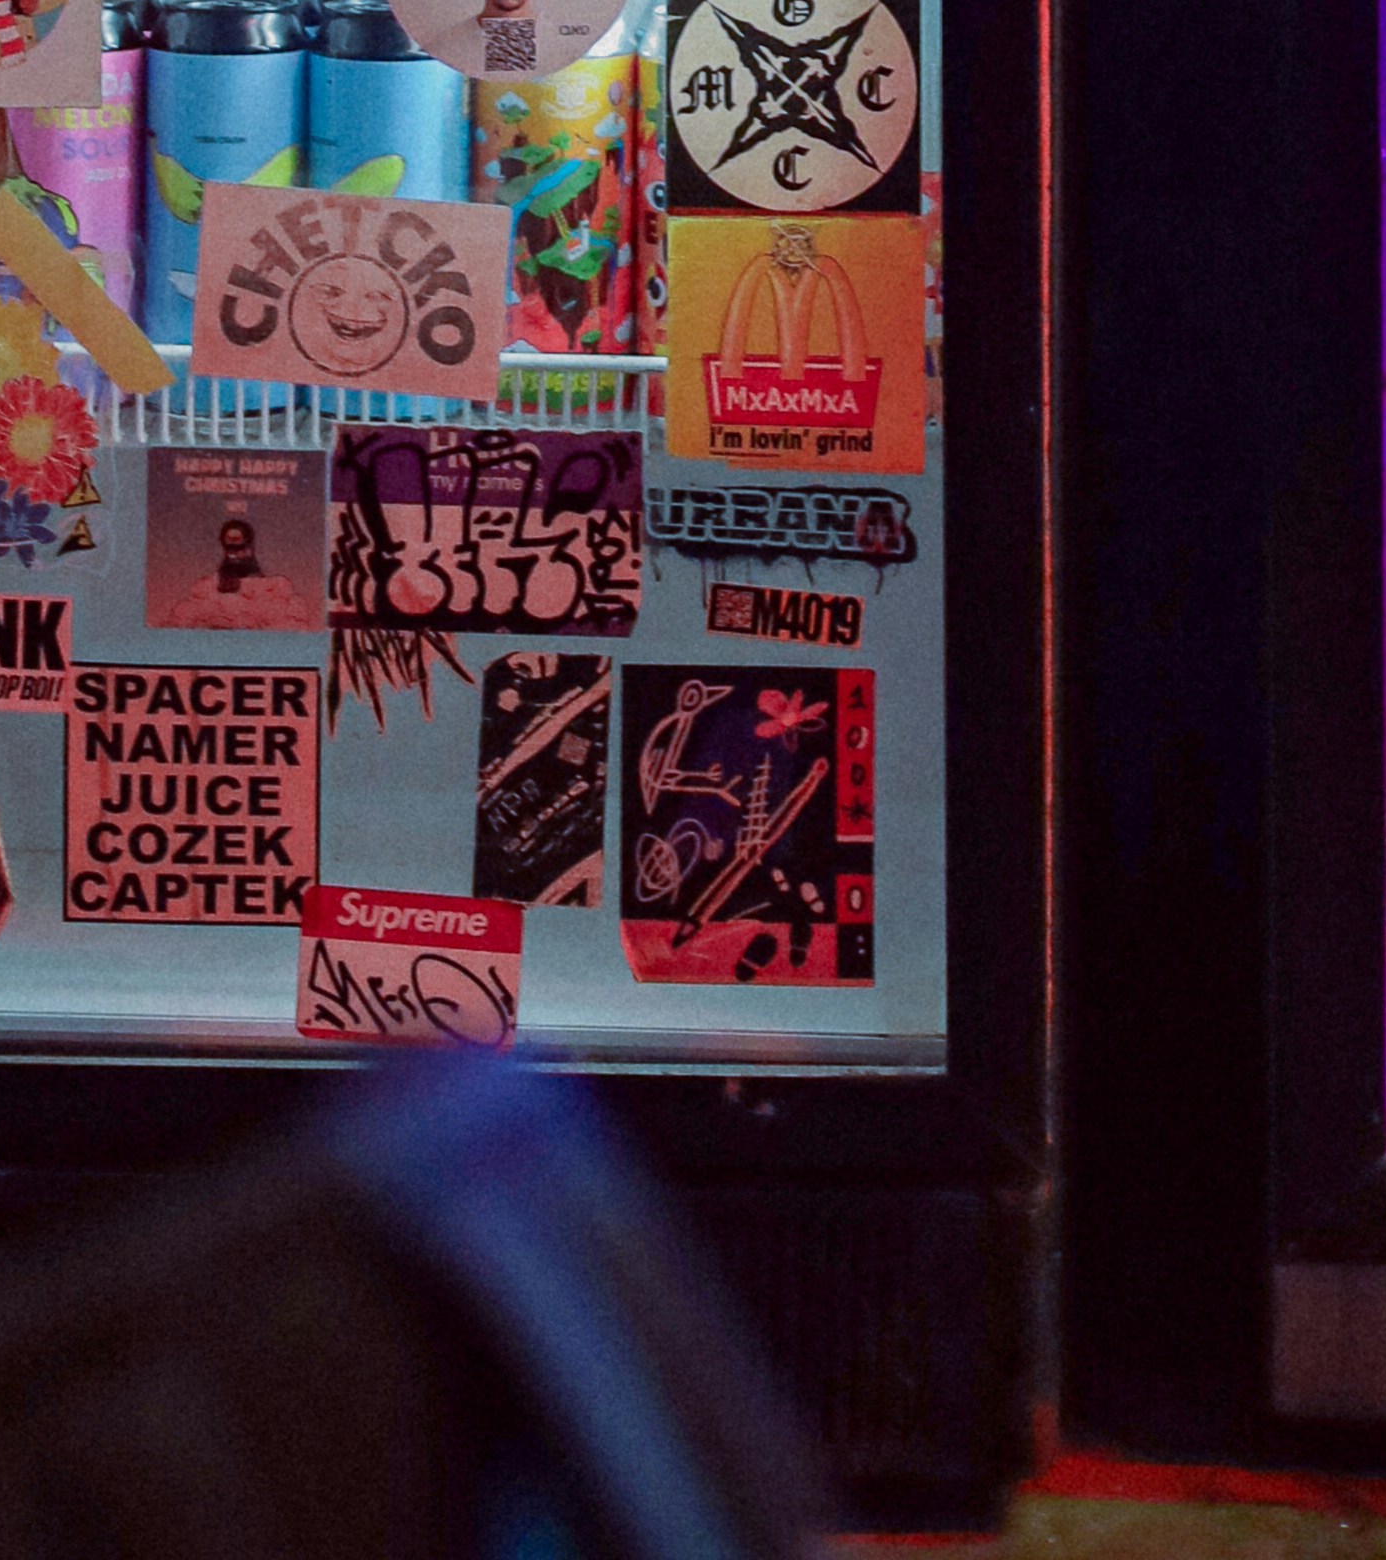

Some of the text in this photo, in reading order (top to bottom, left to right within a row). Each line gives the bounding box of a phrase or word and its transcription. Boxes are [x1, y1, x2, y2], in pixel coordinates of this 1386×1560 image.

[726, 385, 860, 416] MxAxMxA
[750, 425, 874, 456] lovin' grind
[173, 458, 299, 477] HAPPY HAPPY
[755, 586, 862, 647] M4019
[20, 674, 64, 703] BOI!
[73, 672, 309, 718] SPACER
[84, 724, 300, 767] NAMER
[99, 774, 283, 818] JUICE
[86, 822, 294, 868] COZEK
[69, 872, 313, 917] CAPTEK
[336, 890, 489, 940] Supreme
